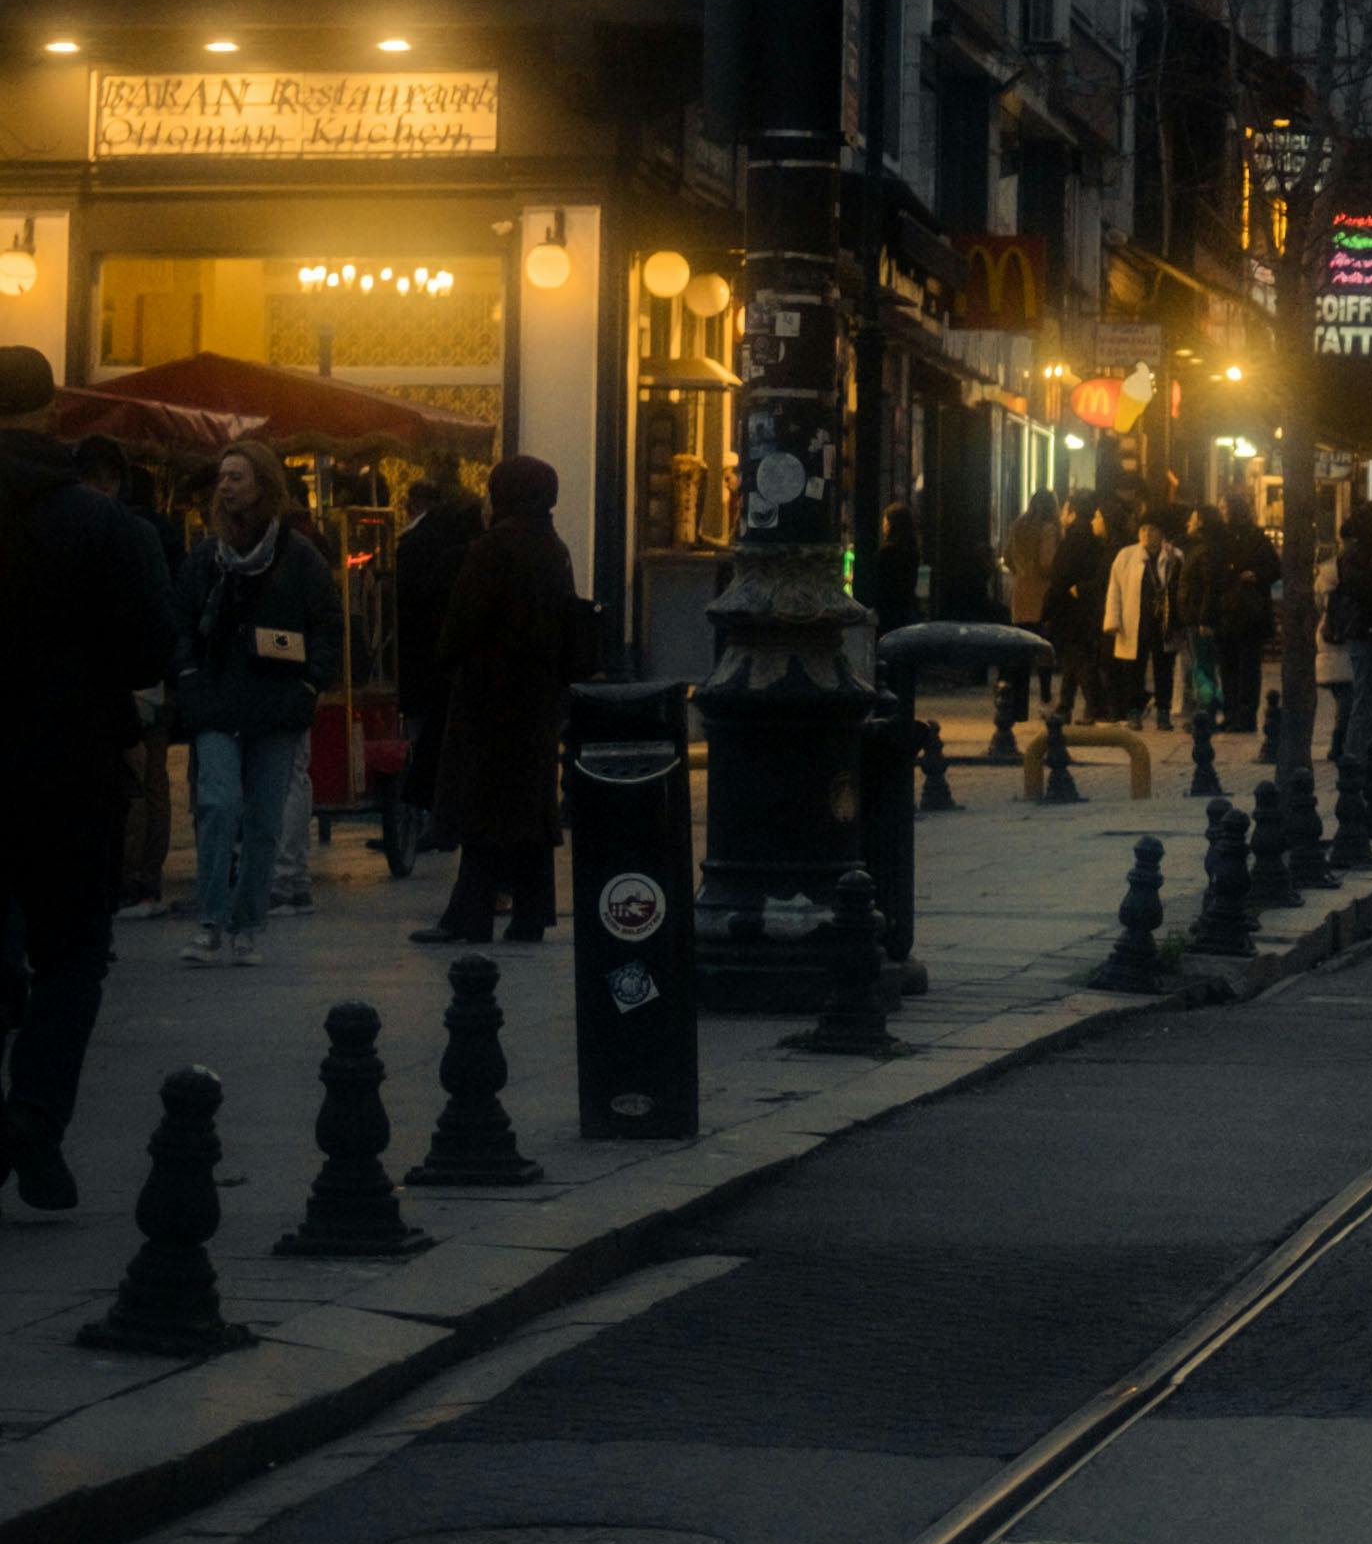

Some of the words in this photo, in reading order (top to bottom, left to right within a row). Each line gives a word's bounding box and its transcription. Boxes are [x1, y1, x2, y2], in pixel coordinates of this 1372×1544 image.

[102, 78, 252, 116] BARAN
[102, 118, 284, 150] Ottoman
[308, 116, 476, 150] Kitchen
